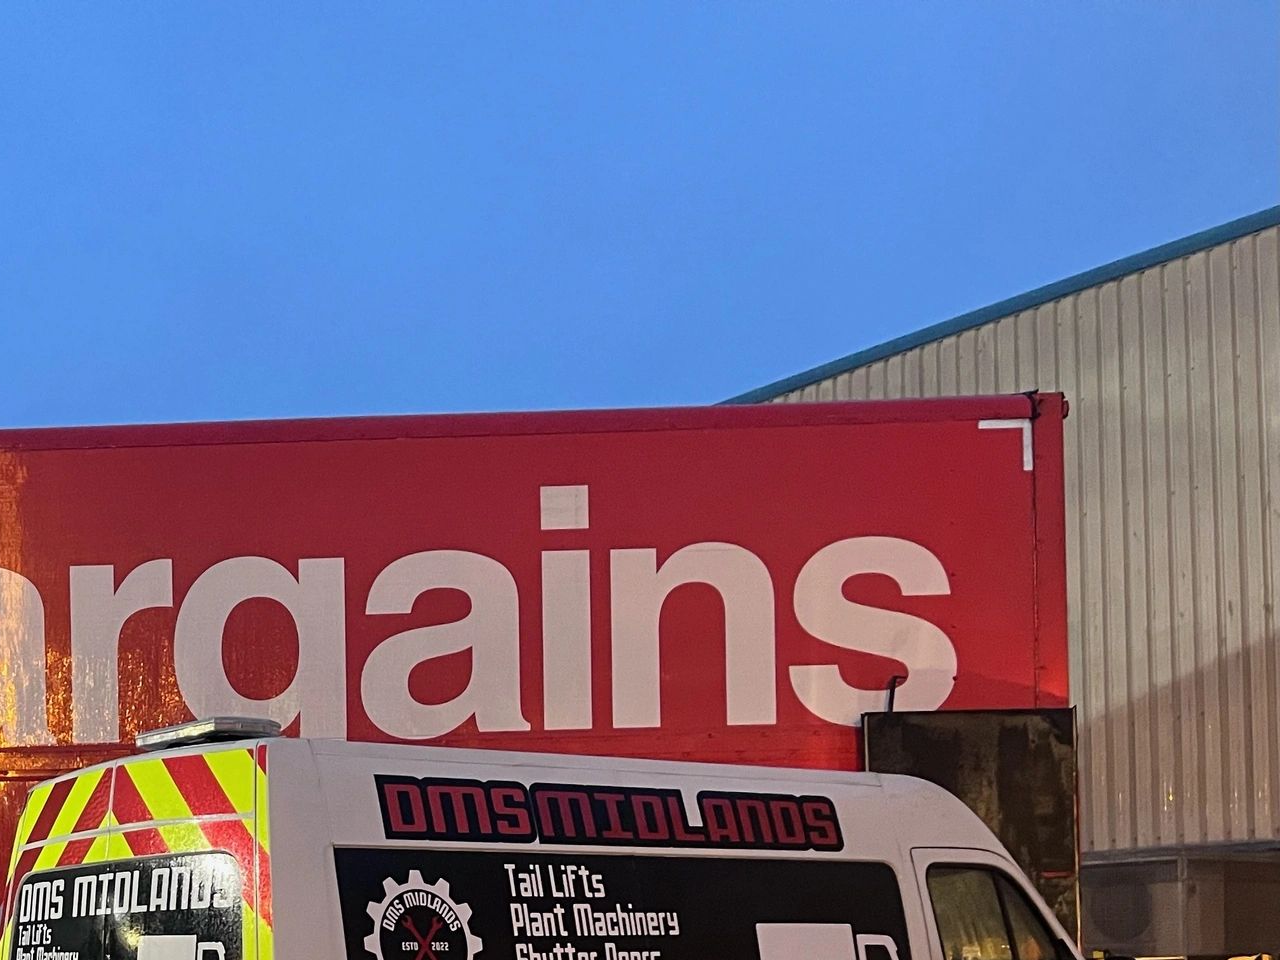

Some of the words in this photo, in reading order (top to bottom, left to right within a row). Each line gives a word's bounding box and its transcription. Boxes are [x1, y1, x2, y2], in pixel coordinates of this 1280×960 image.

[380, 780, 534, 838] DMS
[532, 786, 840, 848] MIDLANDS
[20, 879, 65, 923] DMS
[72, 866, 234, 918] MIDLANDS
[504, 863, 544, 897] Tail
[548, 864, 606, 898] Lifts
[382, 899, 405, 932] DMS
[403, 891, 462, 932] MIDLANDS
[509, 903, 569, 937] Plant
[572, 903, 680, 937] Machinery
[18, 925, 30, 945] Tail
[31, 923, 52, 945] Lifts
[431, 941, 450, 951] 2022
